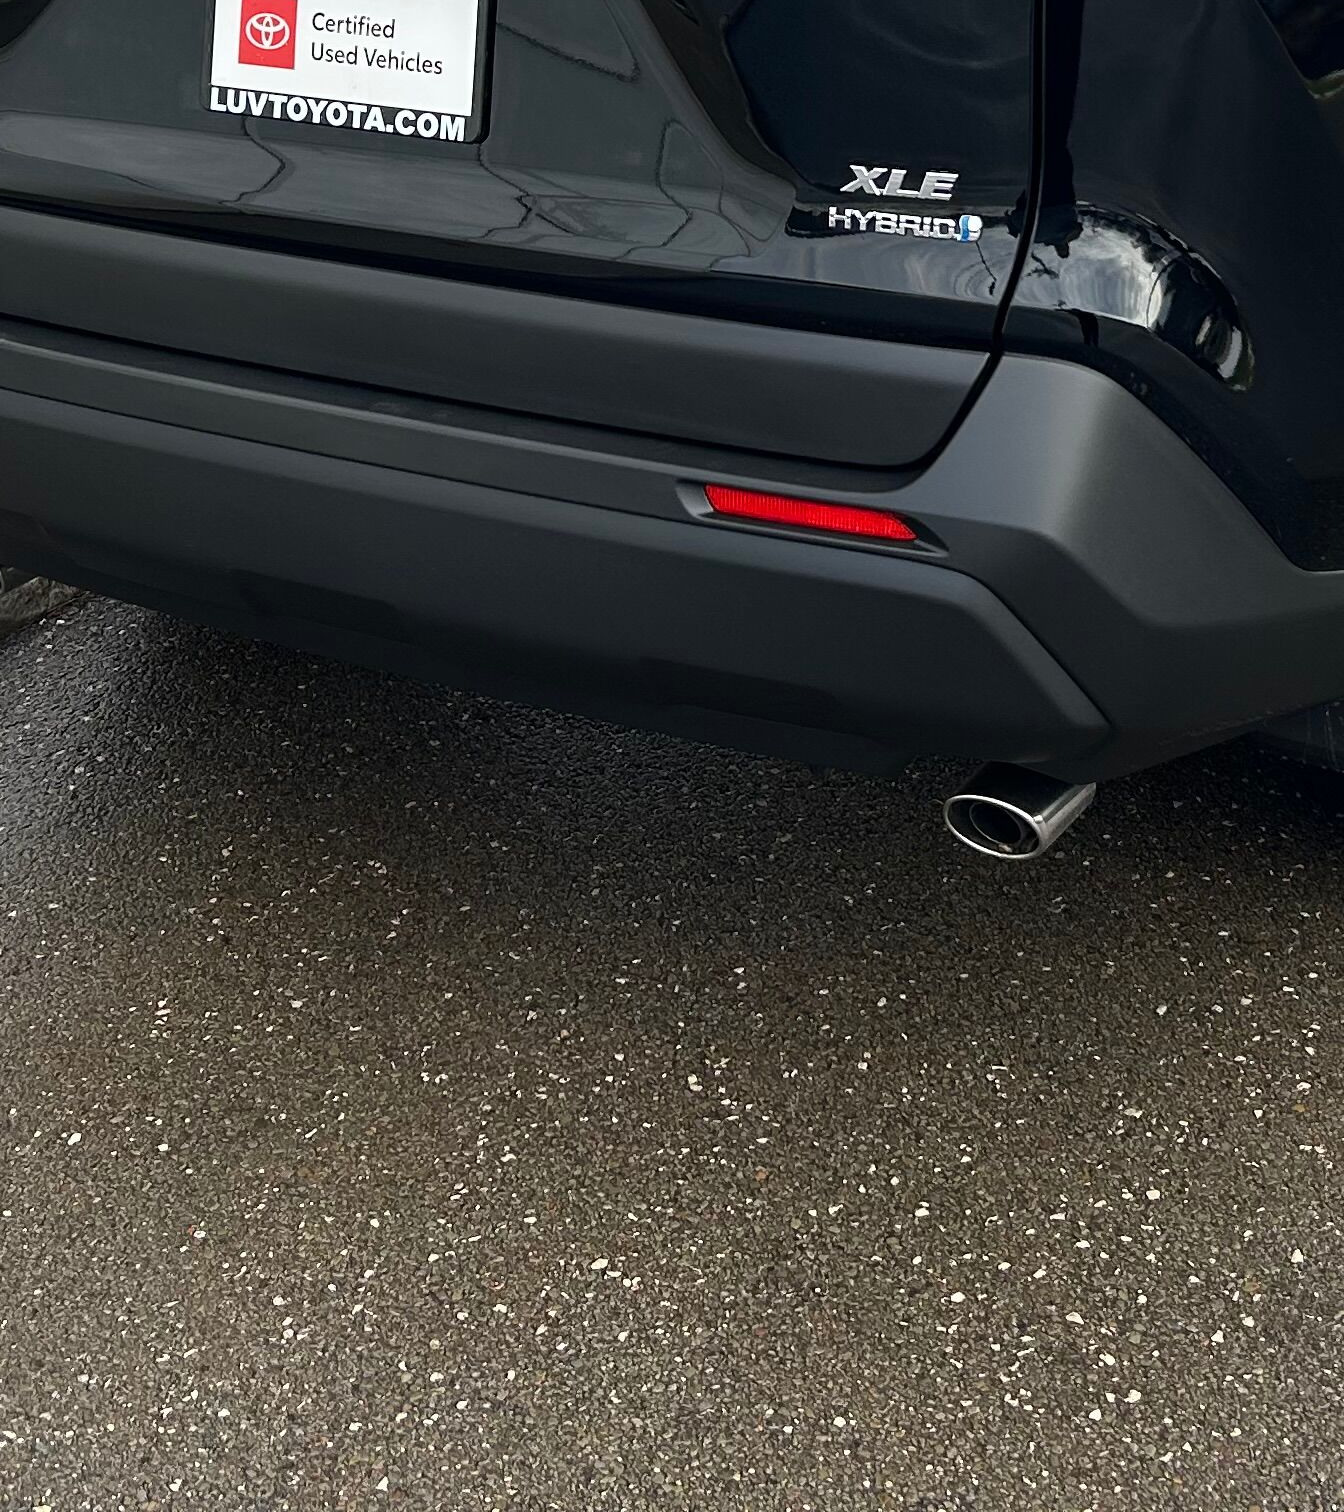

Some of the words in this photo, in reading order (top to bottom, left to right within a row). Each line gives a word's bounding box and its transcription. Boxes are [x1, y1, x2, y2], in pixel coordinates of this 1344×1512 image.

[312, 12, 396, 38] Certified
[311, 42, 358, 66] Used
[364, 46, 443, 75] Vehicles
[209, 87, 466, 142] LUVTOYOTA.COM
[840, 164, 959, 201] XLE
[828, 206, 956, 239] HYBRID
